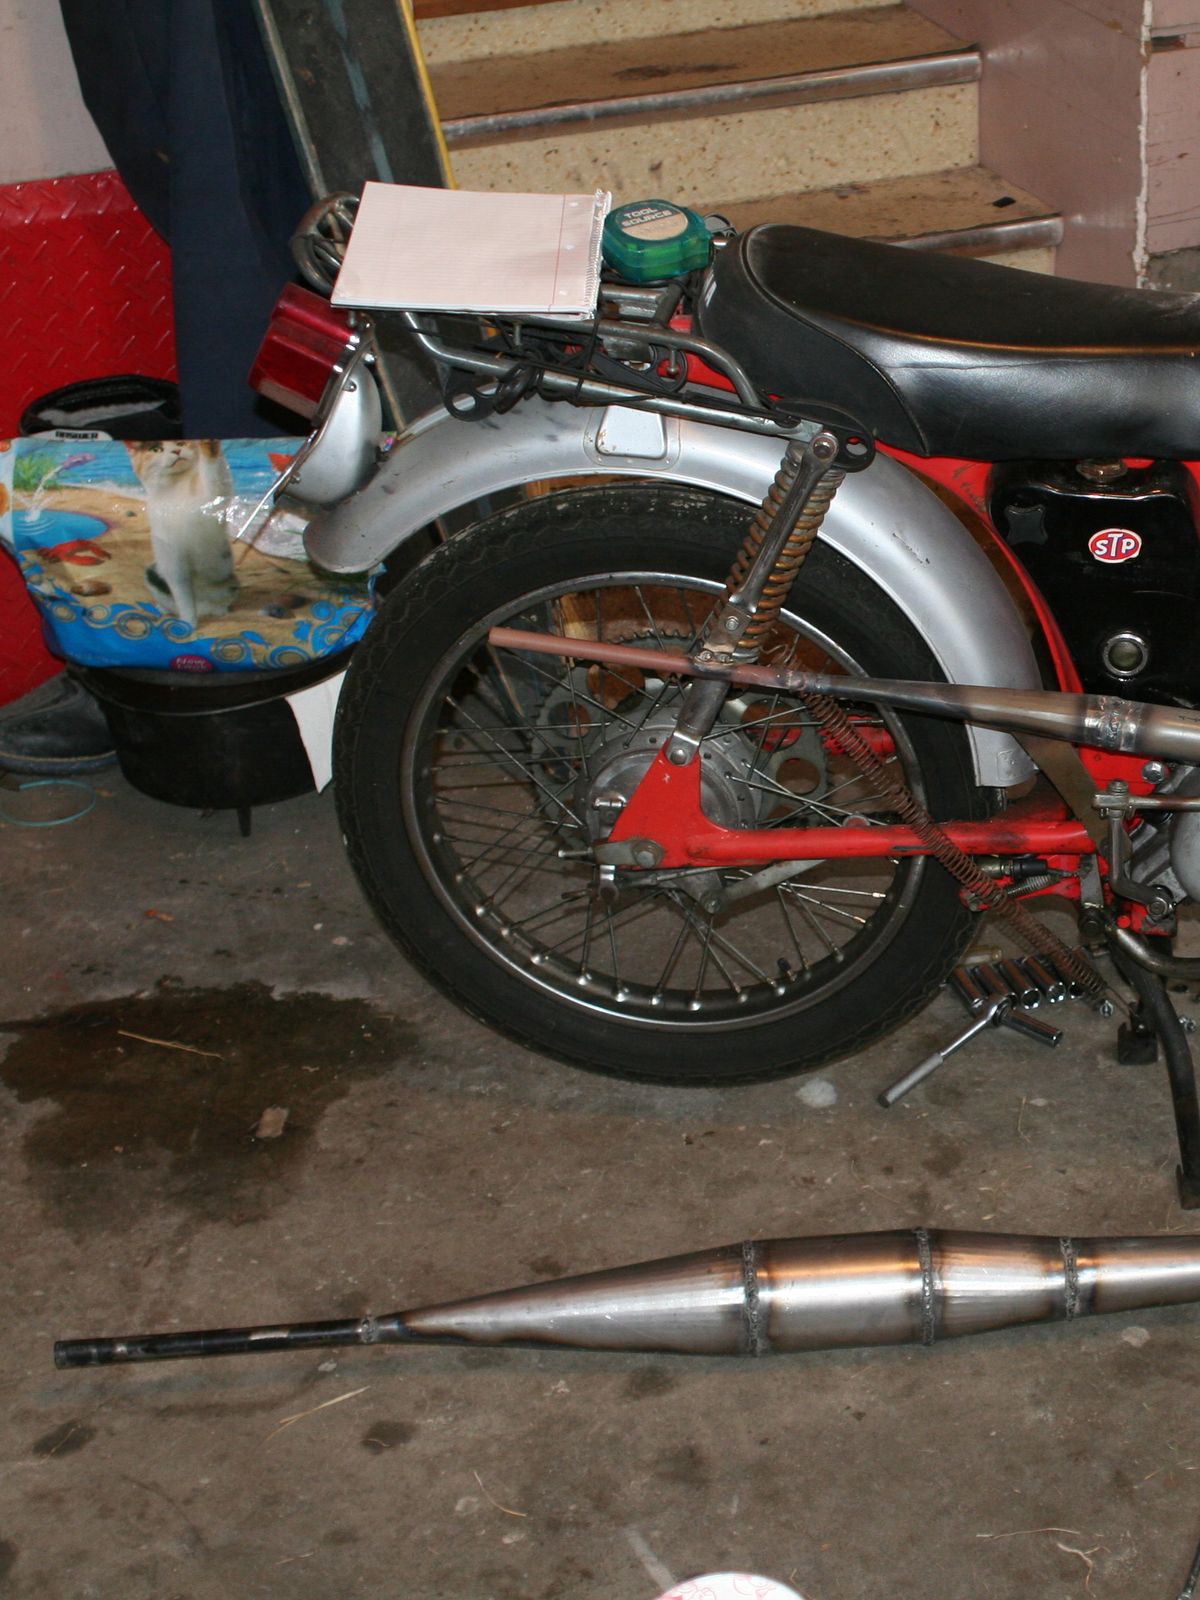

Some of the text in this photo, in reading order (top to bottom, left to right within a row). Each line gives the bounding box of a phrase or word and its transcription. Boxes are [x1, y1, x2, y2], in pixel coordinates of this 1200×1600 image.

[621, 209, 673, 227] SOURCE
[623, 207, 658, 219] TOOL
[1093, 532, 1136, 557] STP
